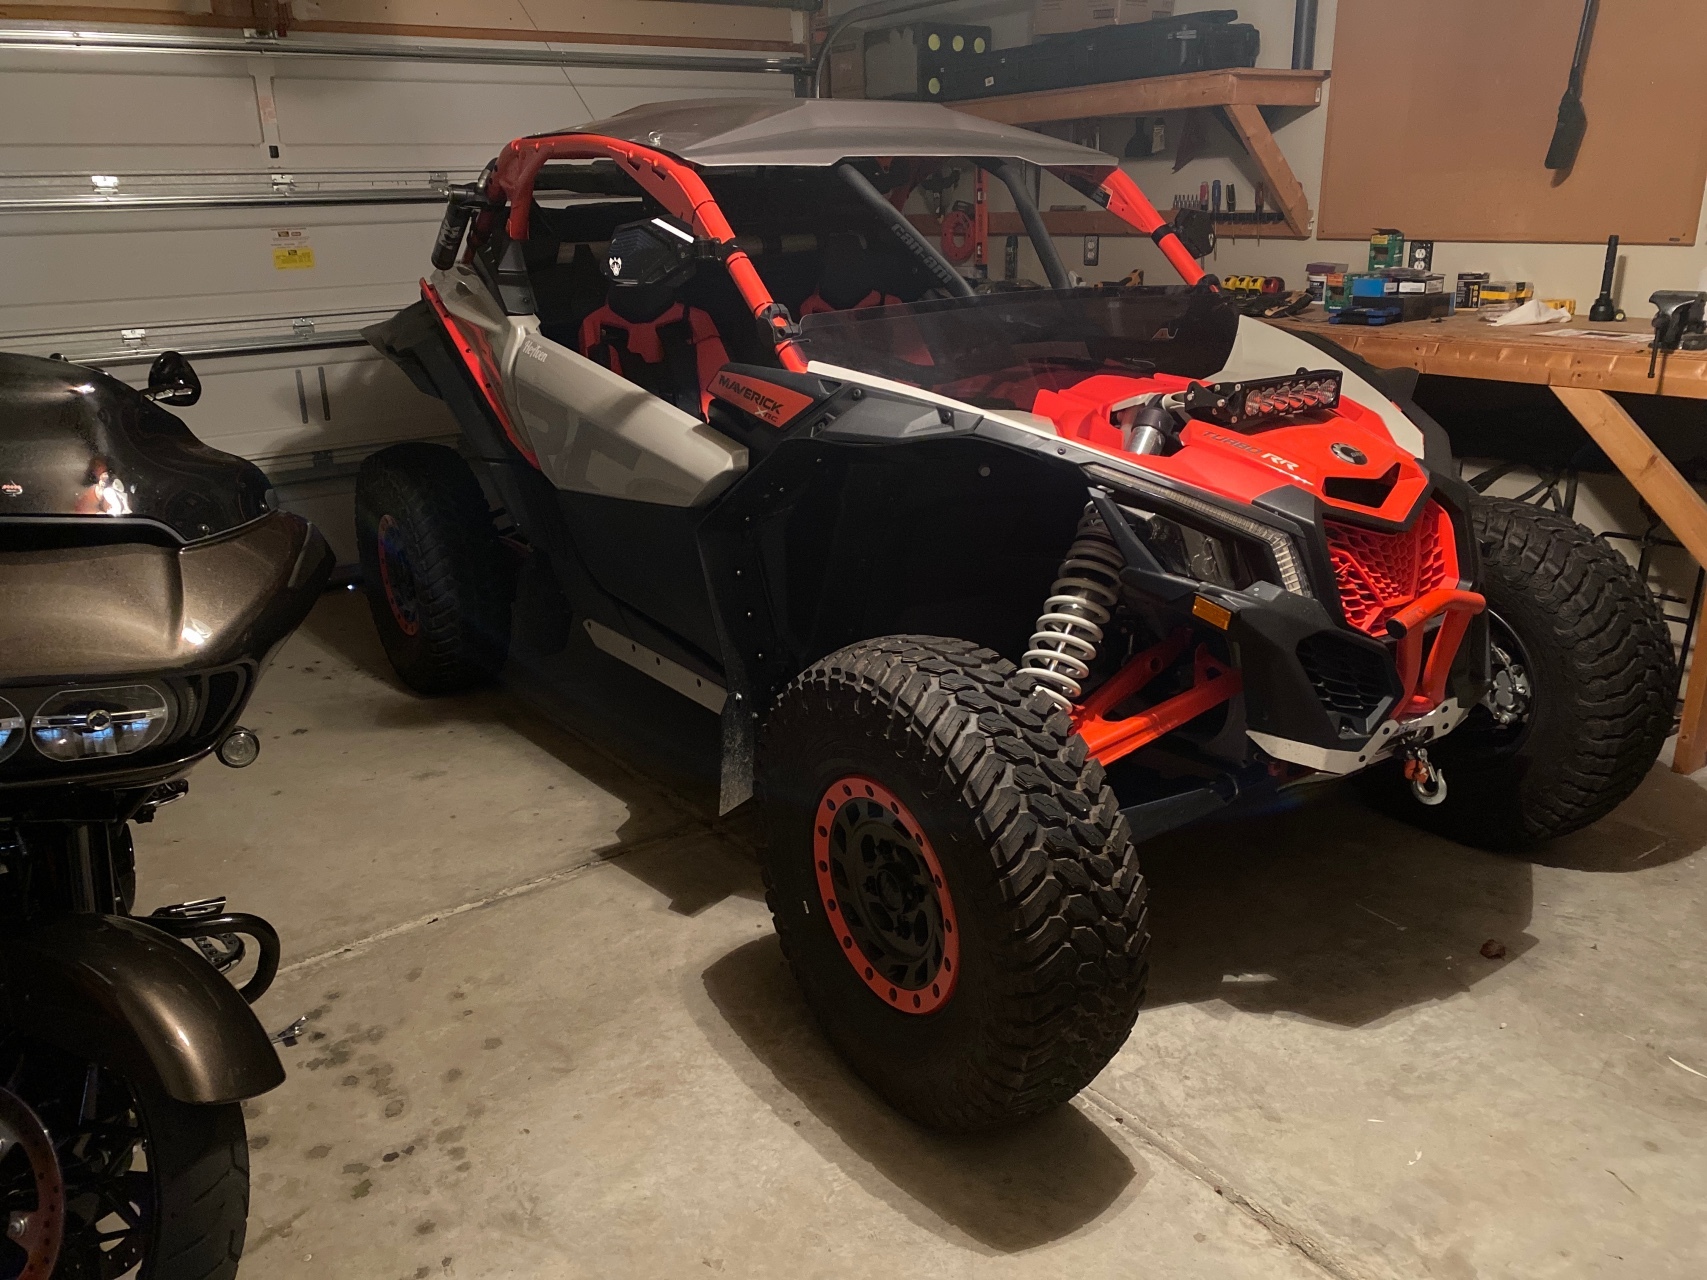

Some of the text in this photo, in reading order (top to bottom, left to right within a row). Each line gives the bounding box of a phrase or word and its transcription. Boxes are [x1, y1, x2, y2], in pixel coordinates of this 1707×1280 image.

[891, 223, 953, 284] can-am
[719, 374, 784, 415] MAVERICK
[1203, 431, 1299, 471] TURBO RR
